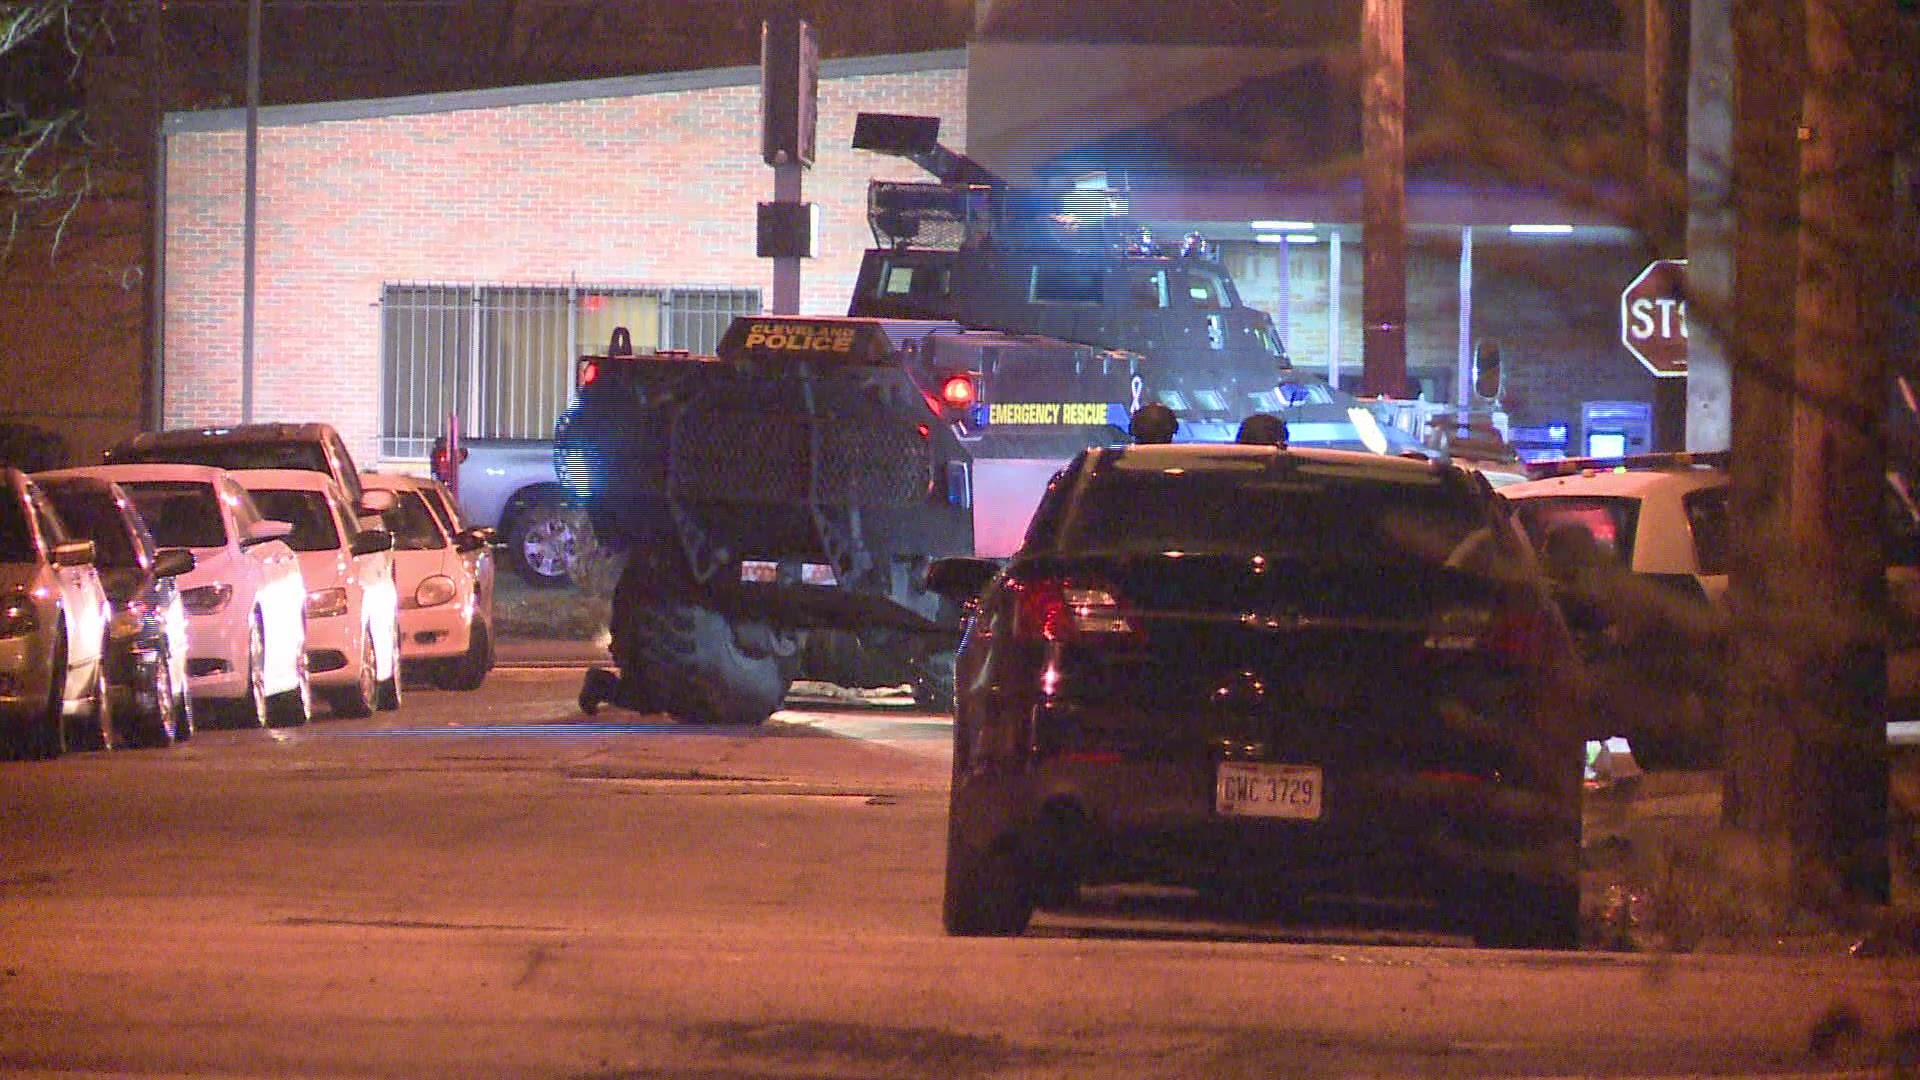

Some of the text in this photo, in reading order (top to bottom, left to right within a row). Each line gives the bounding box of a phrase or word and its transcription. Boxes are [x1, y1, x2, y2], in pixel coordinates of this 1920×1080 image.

[745, 334, 851, 351] POLICE
[989, 403, 1108, 425] EMERGENCY RESCUE
[1267, 777, 1313, 806] 3729
